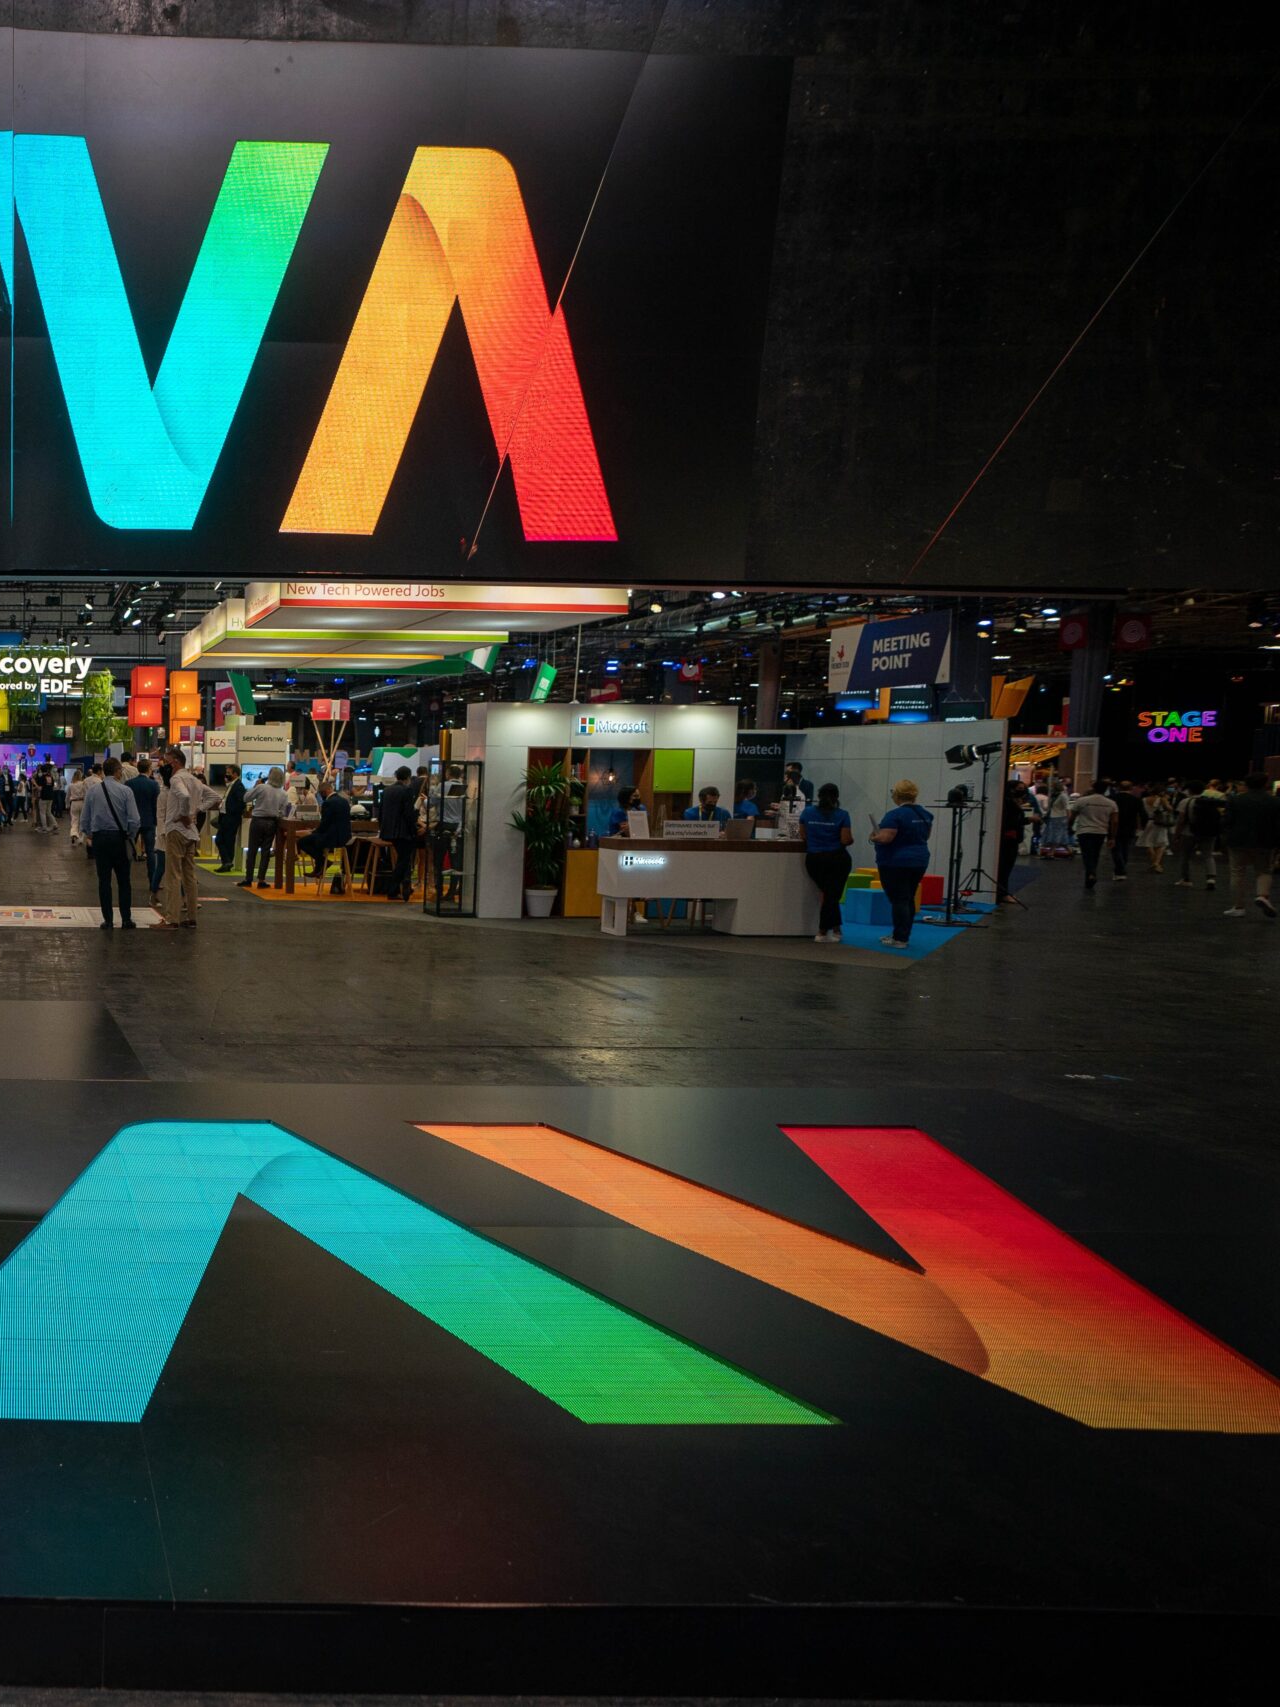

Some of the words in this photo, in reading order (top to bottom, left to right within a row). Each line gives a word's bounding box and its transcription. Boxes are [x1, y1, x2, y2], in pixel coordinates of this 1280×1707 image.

[286, 583, 317, 595] New
[320, 583, 350, 596] Tech
[354, 584, 411, 597] Powered
[415, 585, 445, 598] Jobs
[872, 631, 931, 654] MEETING
[871, 653, 913, 672] POINT
[24, 680, 37, 692] by
[40, 679, 72, 694] EDF
[596, 719, 649, 733] Microsoft
[1137, 710, 1217, 728] STAGE
[1147, 727, 1203, 743] ONE
